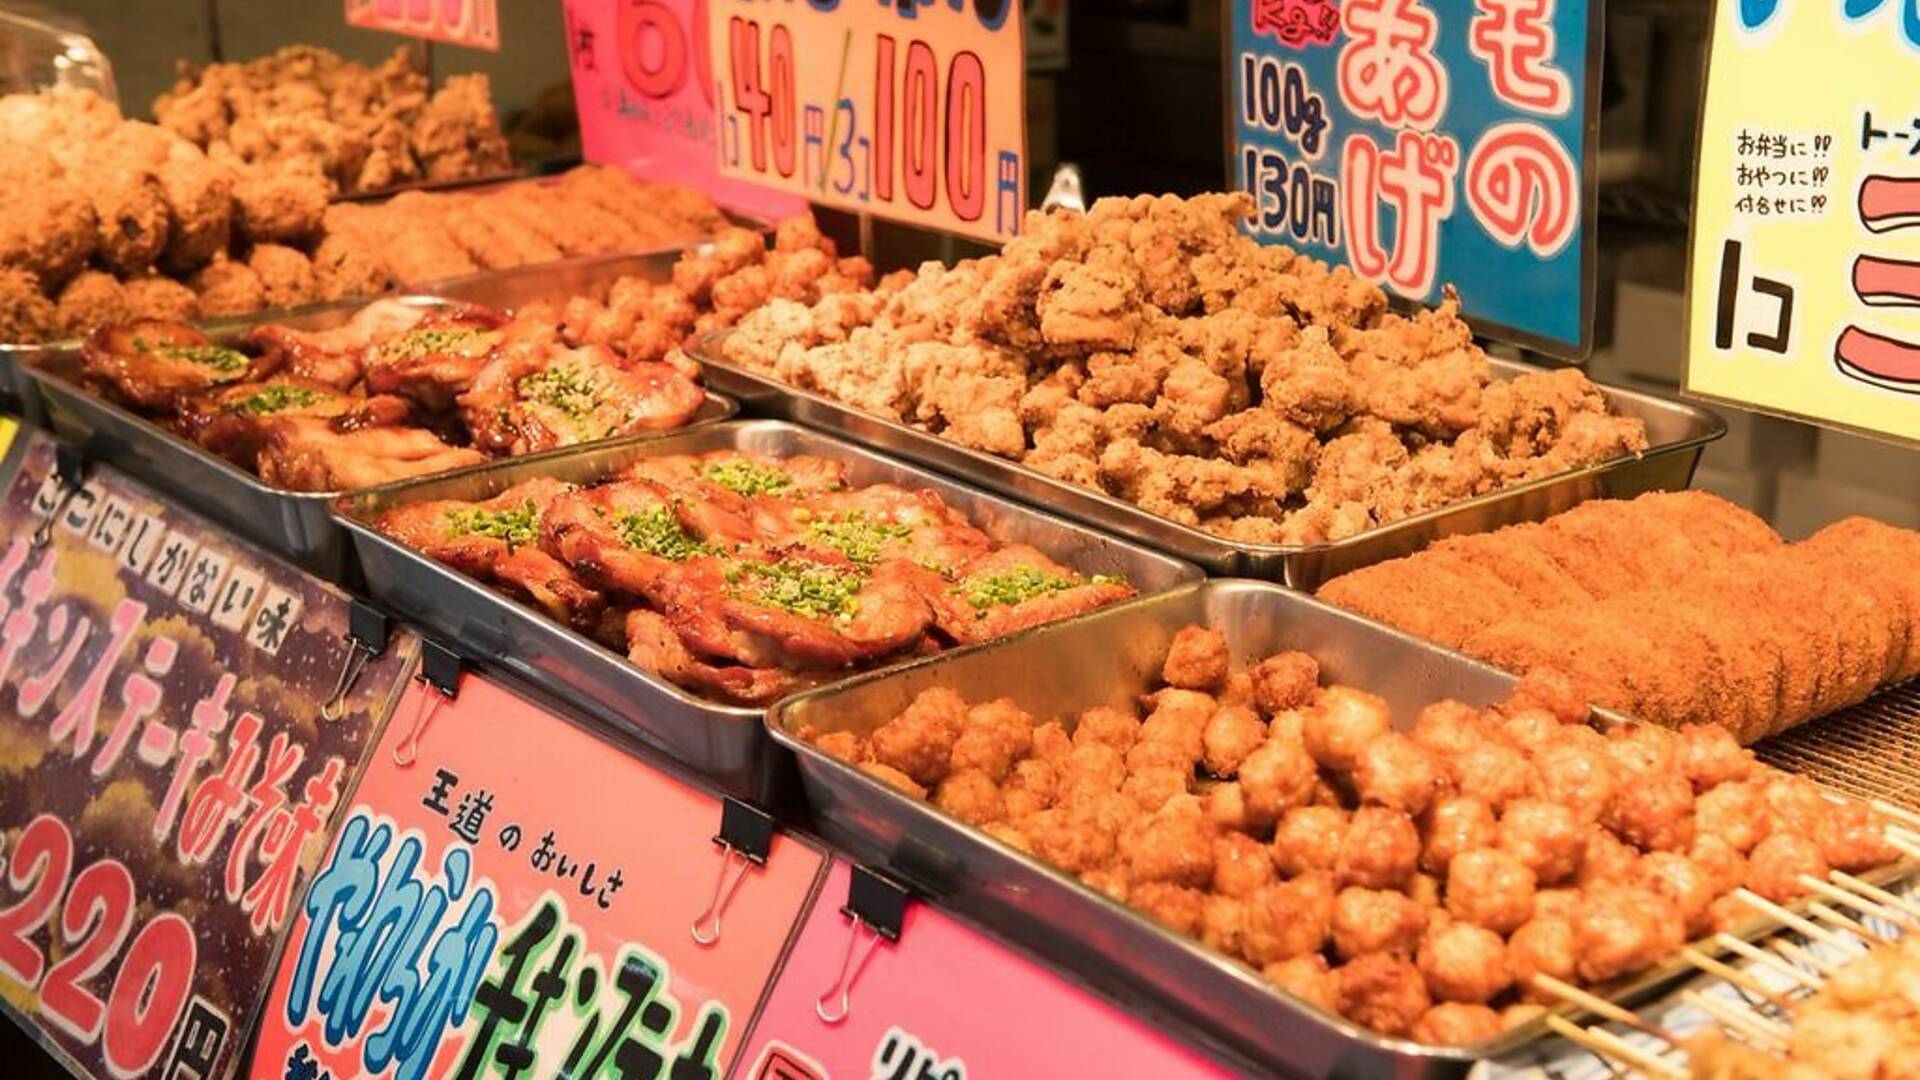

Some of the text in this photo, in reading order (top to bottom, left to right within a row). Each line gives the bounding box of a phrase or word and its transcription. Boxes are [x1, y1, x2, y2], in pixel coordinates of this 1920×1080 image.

[1244, 56, 1327, 154] 100g
[1245, 149, 1336, 246] 130円
[1716, 239, 1794, 354] 1コ
